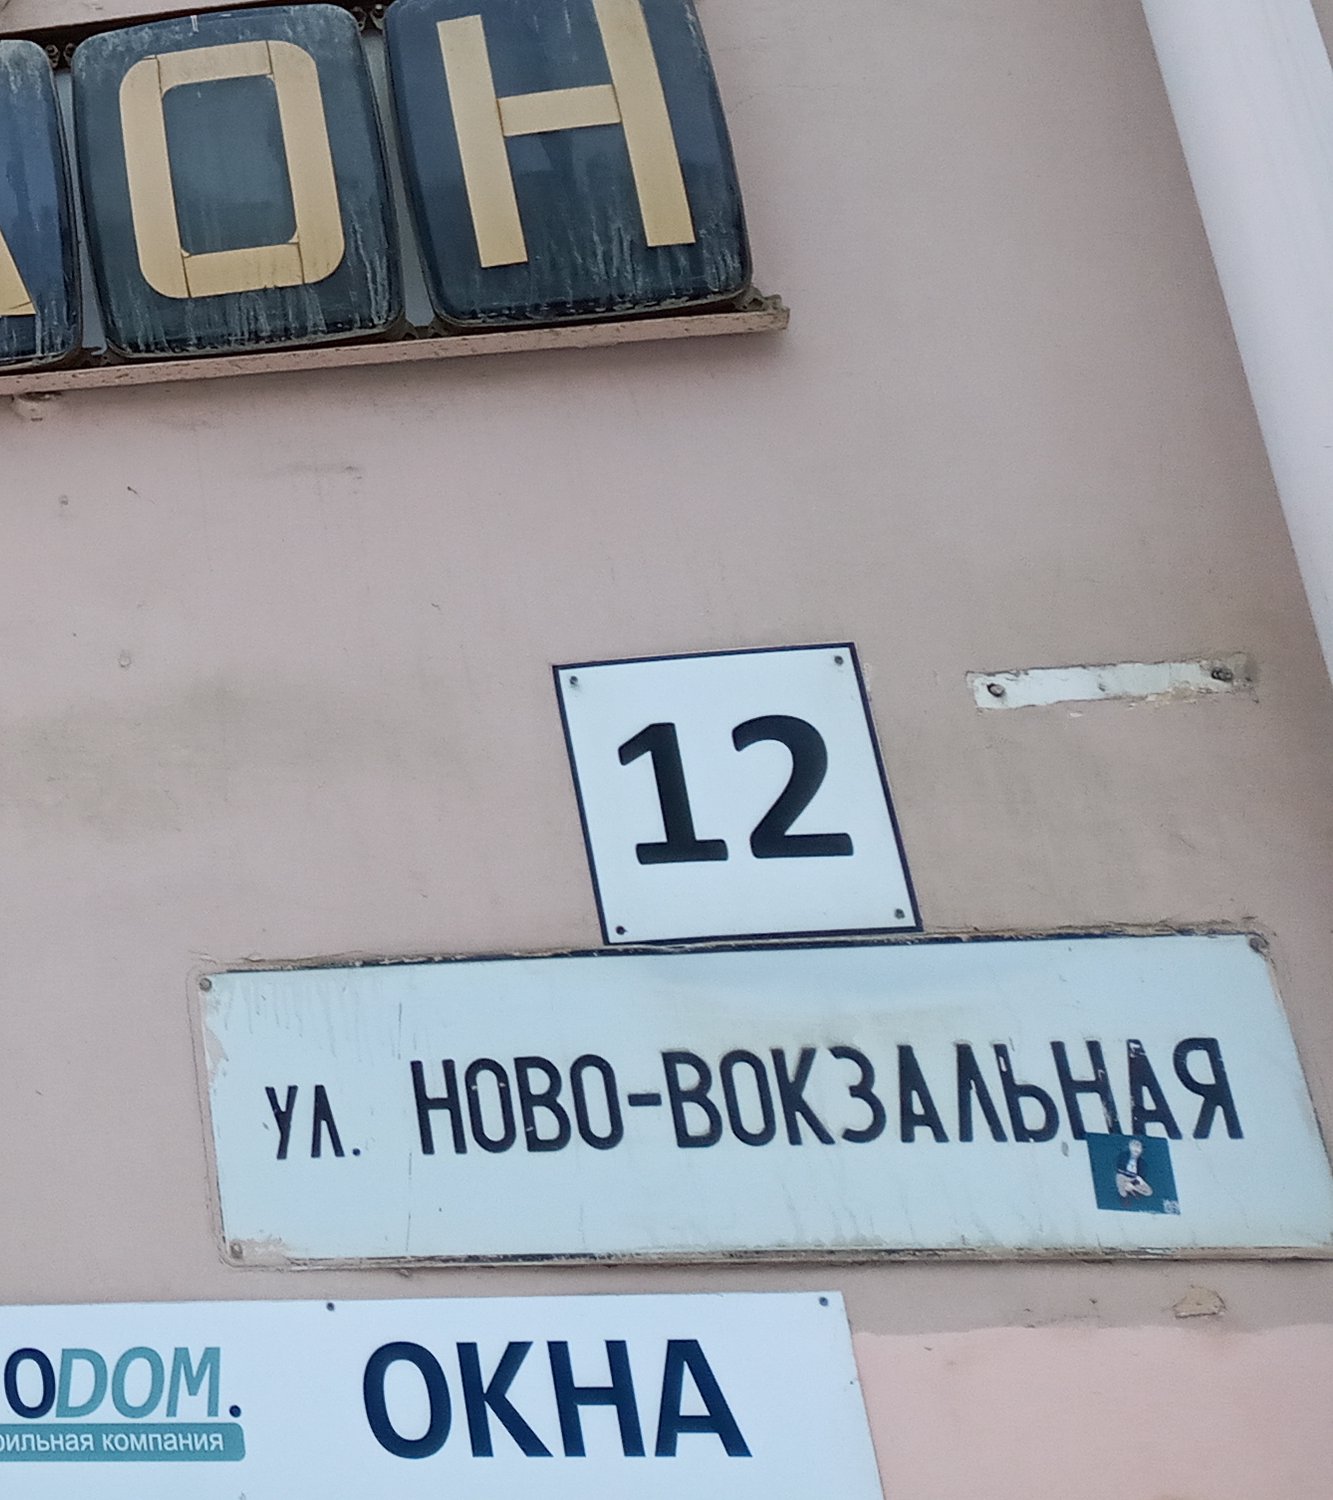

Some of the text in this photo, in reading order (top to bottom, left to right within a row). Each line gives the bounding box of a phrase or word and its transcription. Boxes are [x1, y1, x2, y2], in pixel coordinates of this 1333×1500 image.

[617, 713, 854, 866] 12
[410, 1037, 1244, 1155] НОВО-ВОКЗАЛЬНАЯ
[102, 1429, 224, 1454] компания
[362, 1338, 752, 1460] ОКНА
